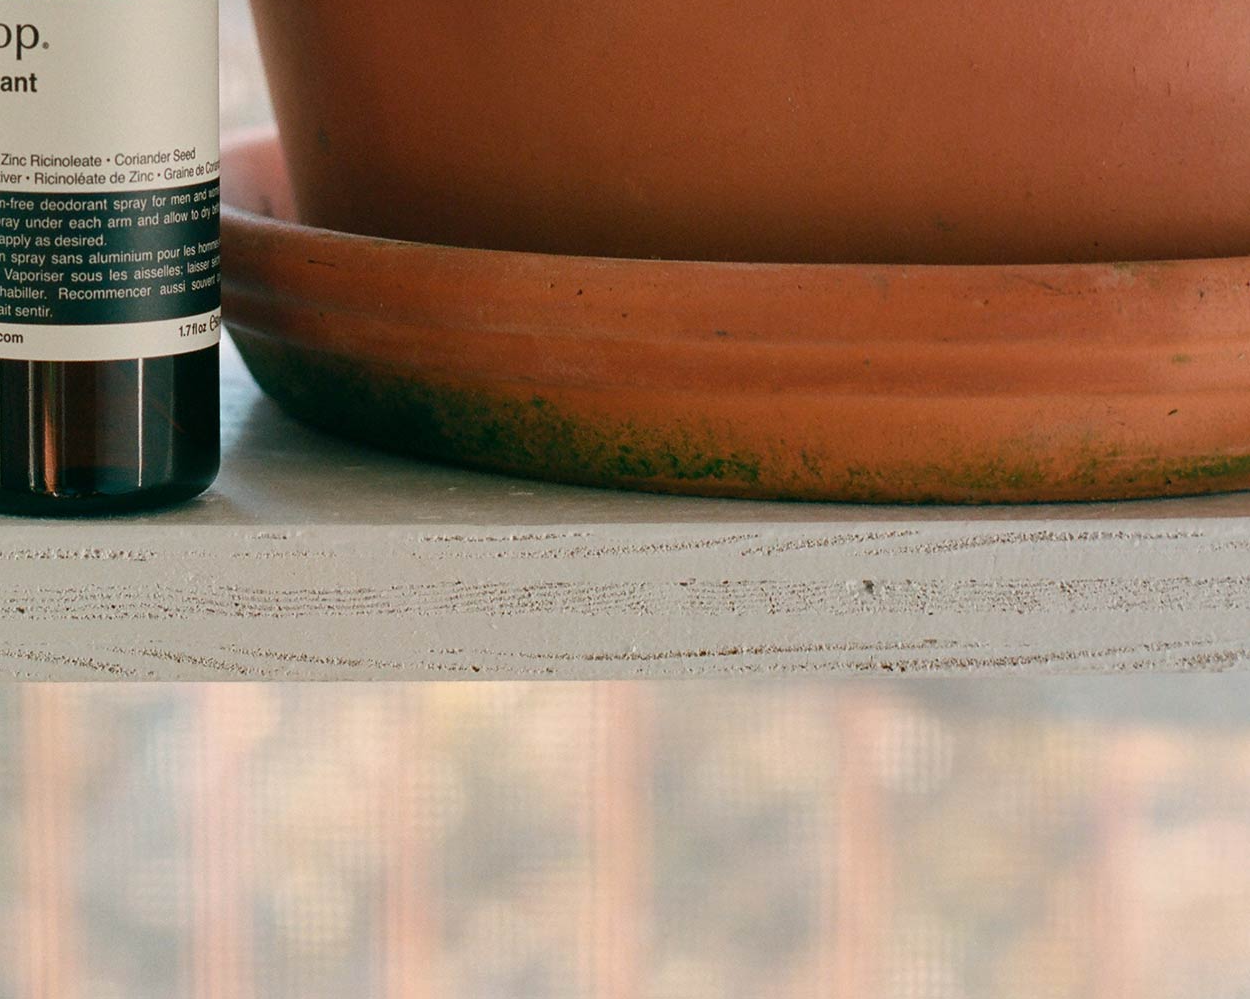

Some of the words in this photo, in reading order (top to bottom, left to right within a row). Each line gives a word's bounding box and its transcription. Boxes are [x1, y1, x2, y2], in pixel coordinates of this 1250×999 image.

[1, 153, 27, 166] Zinc
[30, 154, 102, 167] Ricinoleate
[114, 151, 171, 166] Coriander
[173, 147, 196, 162] Seed
[34, 171, 106, 185] Ricinoléate
[109, 171, 125, 184] de
[128, 170, 154, 183] Zinc
[163, 167, 194, 181] Graine
[195, 164, 205, 177] de
[39, 198, 108, 212] deodorant
[113, 197, 147, 212] spray
[152, 194, 167, 208] for
[170, 192, 191, 206] men
[193, 188, 207, 202] and
[25, 216, 63, 230] under
[68, 216, 102, 230] each
[107, 216, 133, 230] arm
[137, 213, 160, 227] and
[163, 210, 189, 225] allow
[191, 207, 200, 220] to
[35, 236, 51, 248] as
[54, 233, 108, 248] desired.
[11, 253, 46, 268] spray
[51, 254, 84, 265] sans
[89, 249, 153, 265] aluminium
[157, 246, 181, 264] pour
[183, 243, 196, 257] les
[4, 267, 65, 284] Vaporiser
[70, 271, 103, 282] sous
[109, 268, 128, 281] les
[187, 259, 210, 274] laisser
[58, 286, 152, 301] Recommencer
[159, 280, 186, 296] aussi
[14, 305, 54, 319] sentir.
